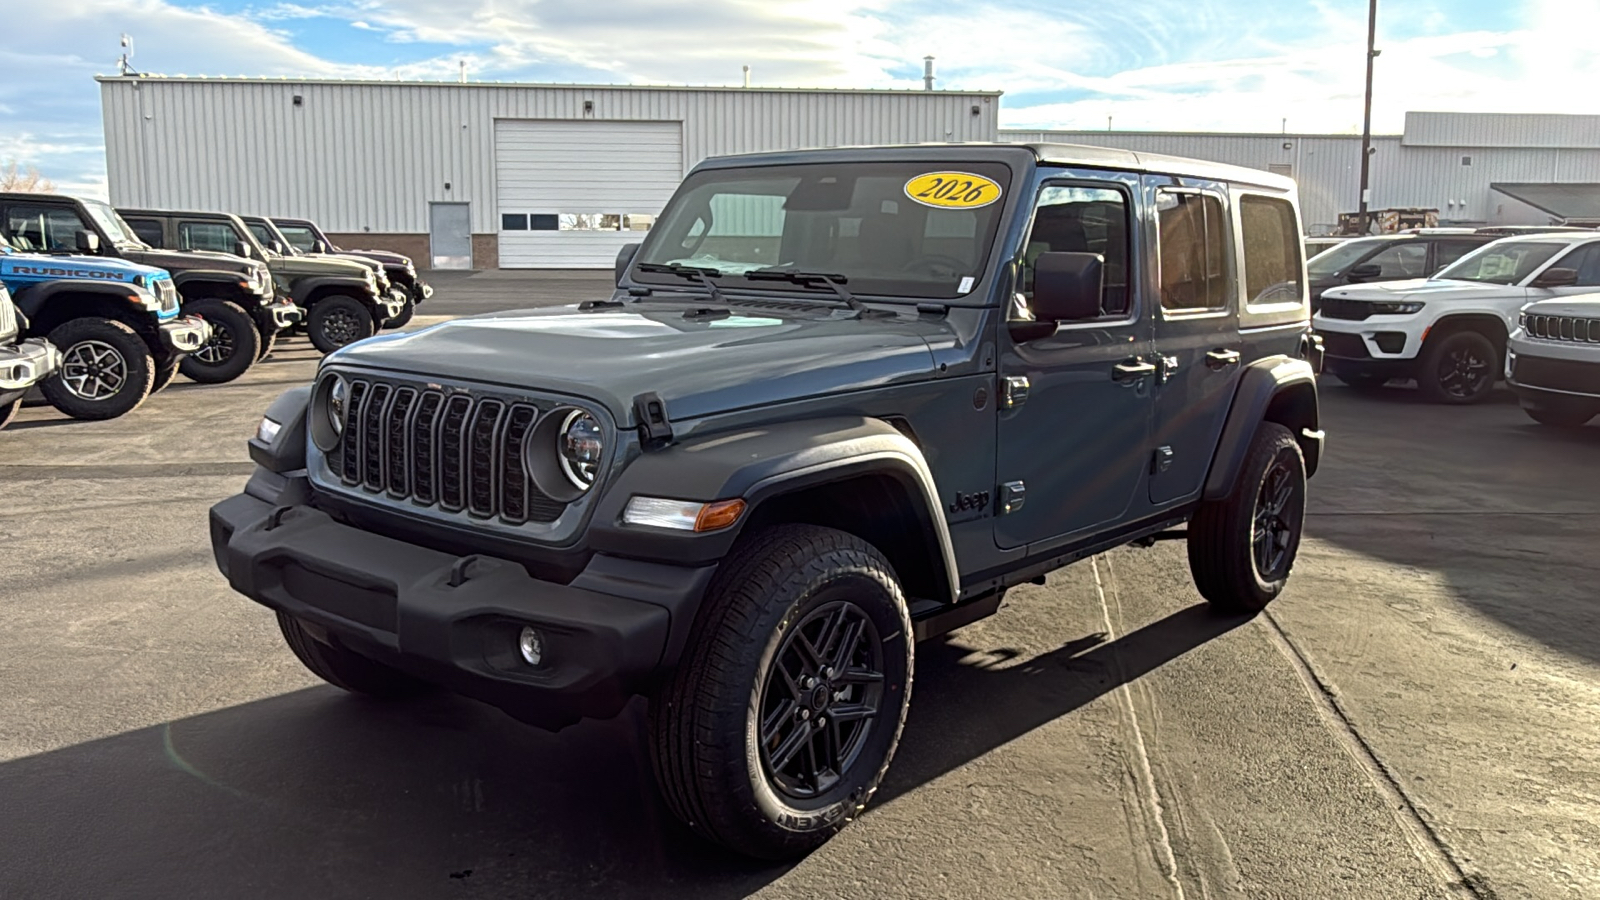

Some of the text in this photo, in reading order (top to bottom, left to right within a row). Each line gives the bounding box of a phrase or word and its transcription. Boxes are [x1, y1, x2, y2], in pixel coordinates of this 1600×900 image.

[916, 177, 991, 202] 2026
[12, 266, 124, 279] RUBICON
[949, 490, 989, 513] Jeep
